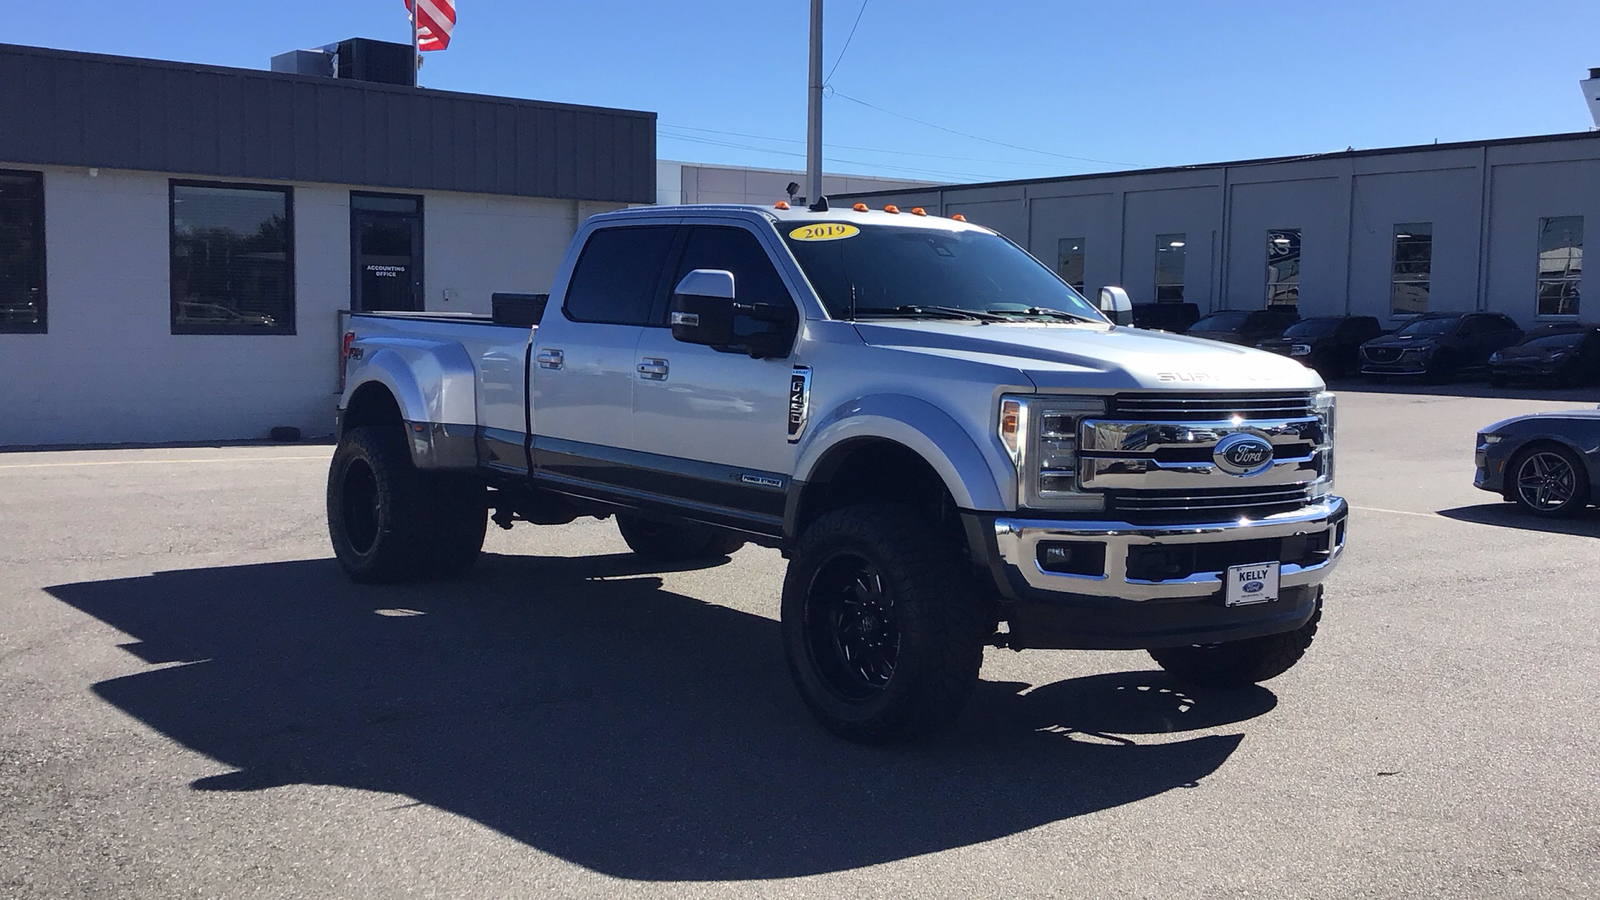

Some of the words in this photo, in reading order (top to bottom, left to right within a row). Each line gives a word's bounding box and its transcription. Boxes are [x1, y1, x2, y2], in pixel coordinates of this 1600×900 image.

[803, 225, 846, 239] 2019
[1234, 444, 1265, 463] Ford
[1239, 569, 1269, 582] KELLY
